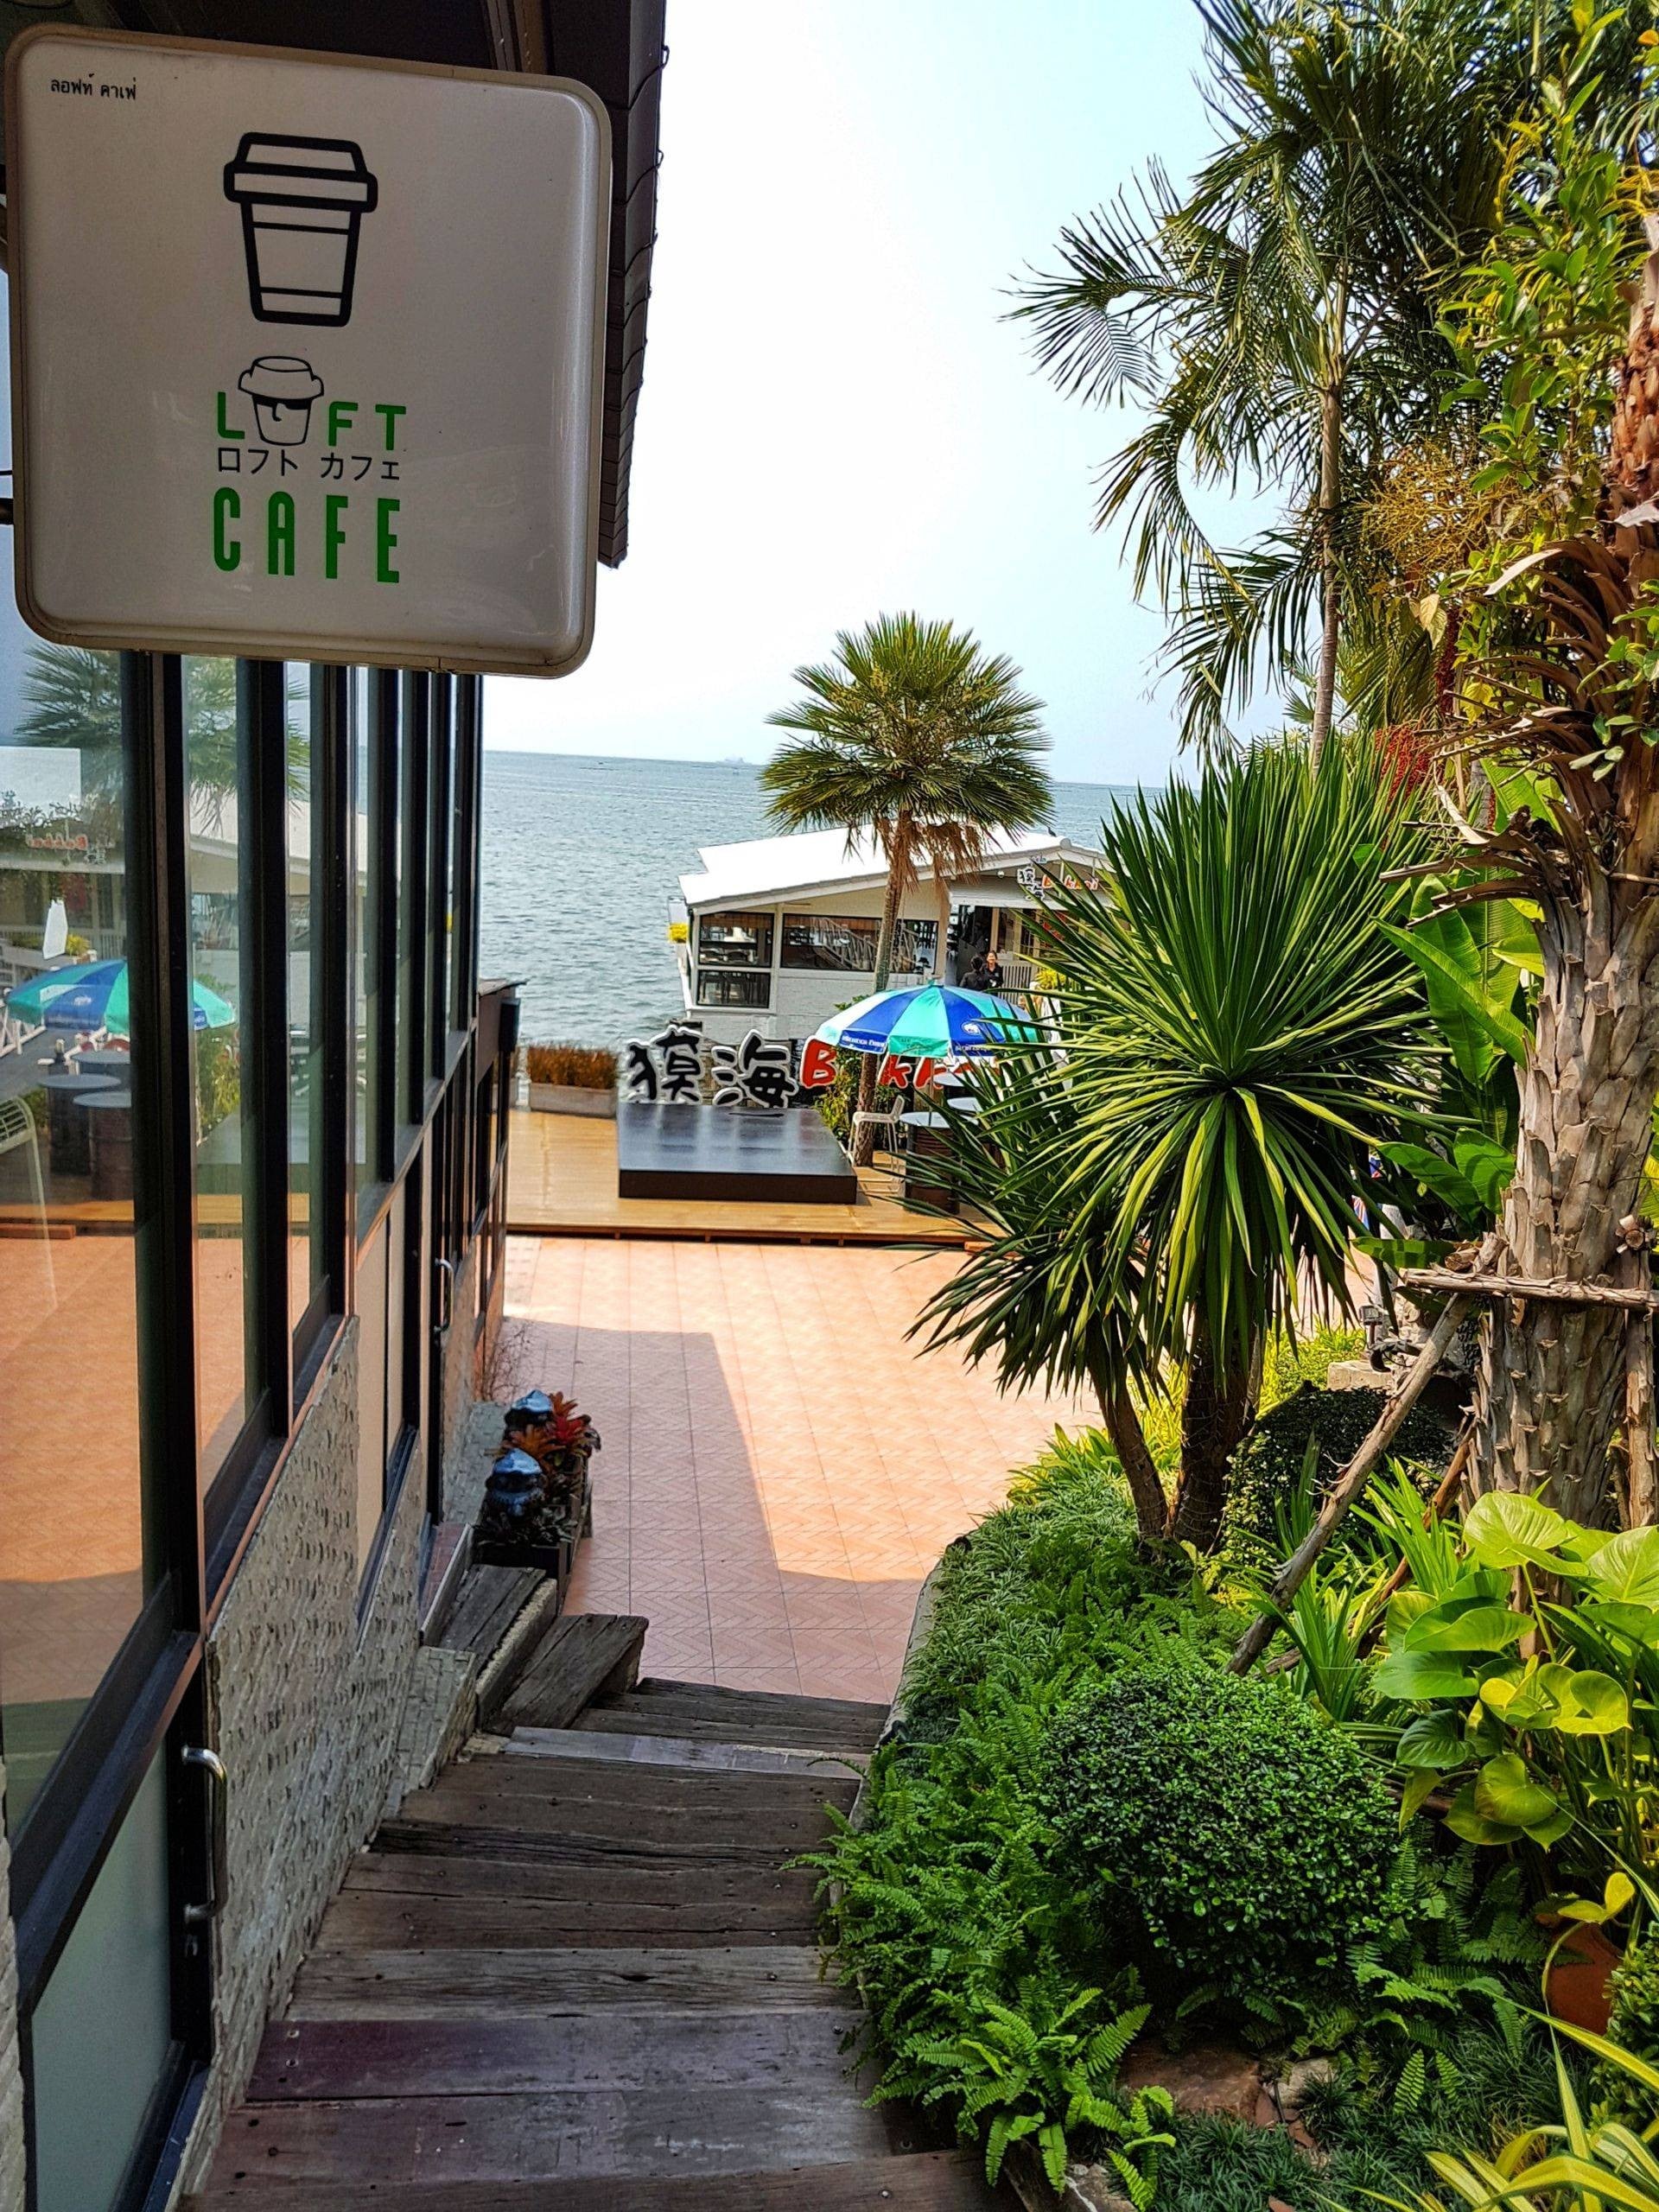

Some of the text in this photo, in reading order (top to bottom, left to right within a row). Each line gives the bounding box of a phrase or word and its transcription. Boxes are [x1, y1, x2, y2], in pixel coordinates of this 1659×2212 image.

[51, 73, 137, 100] ลอฟท์ คาเฟ่
[218, 447, 400, 481] ロフト カフェ
[213, 486, 400, 583] CAFE
